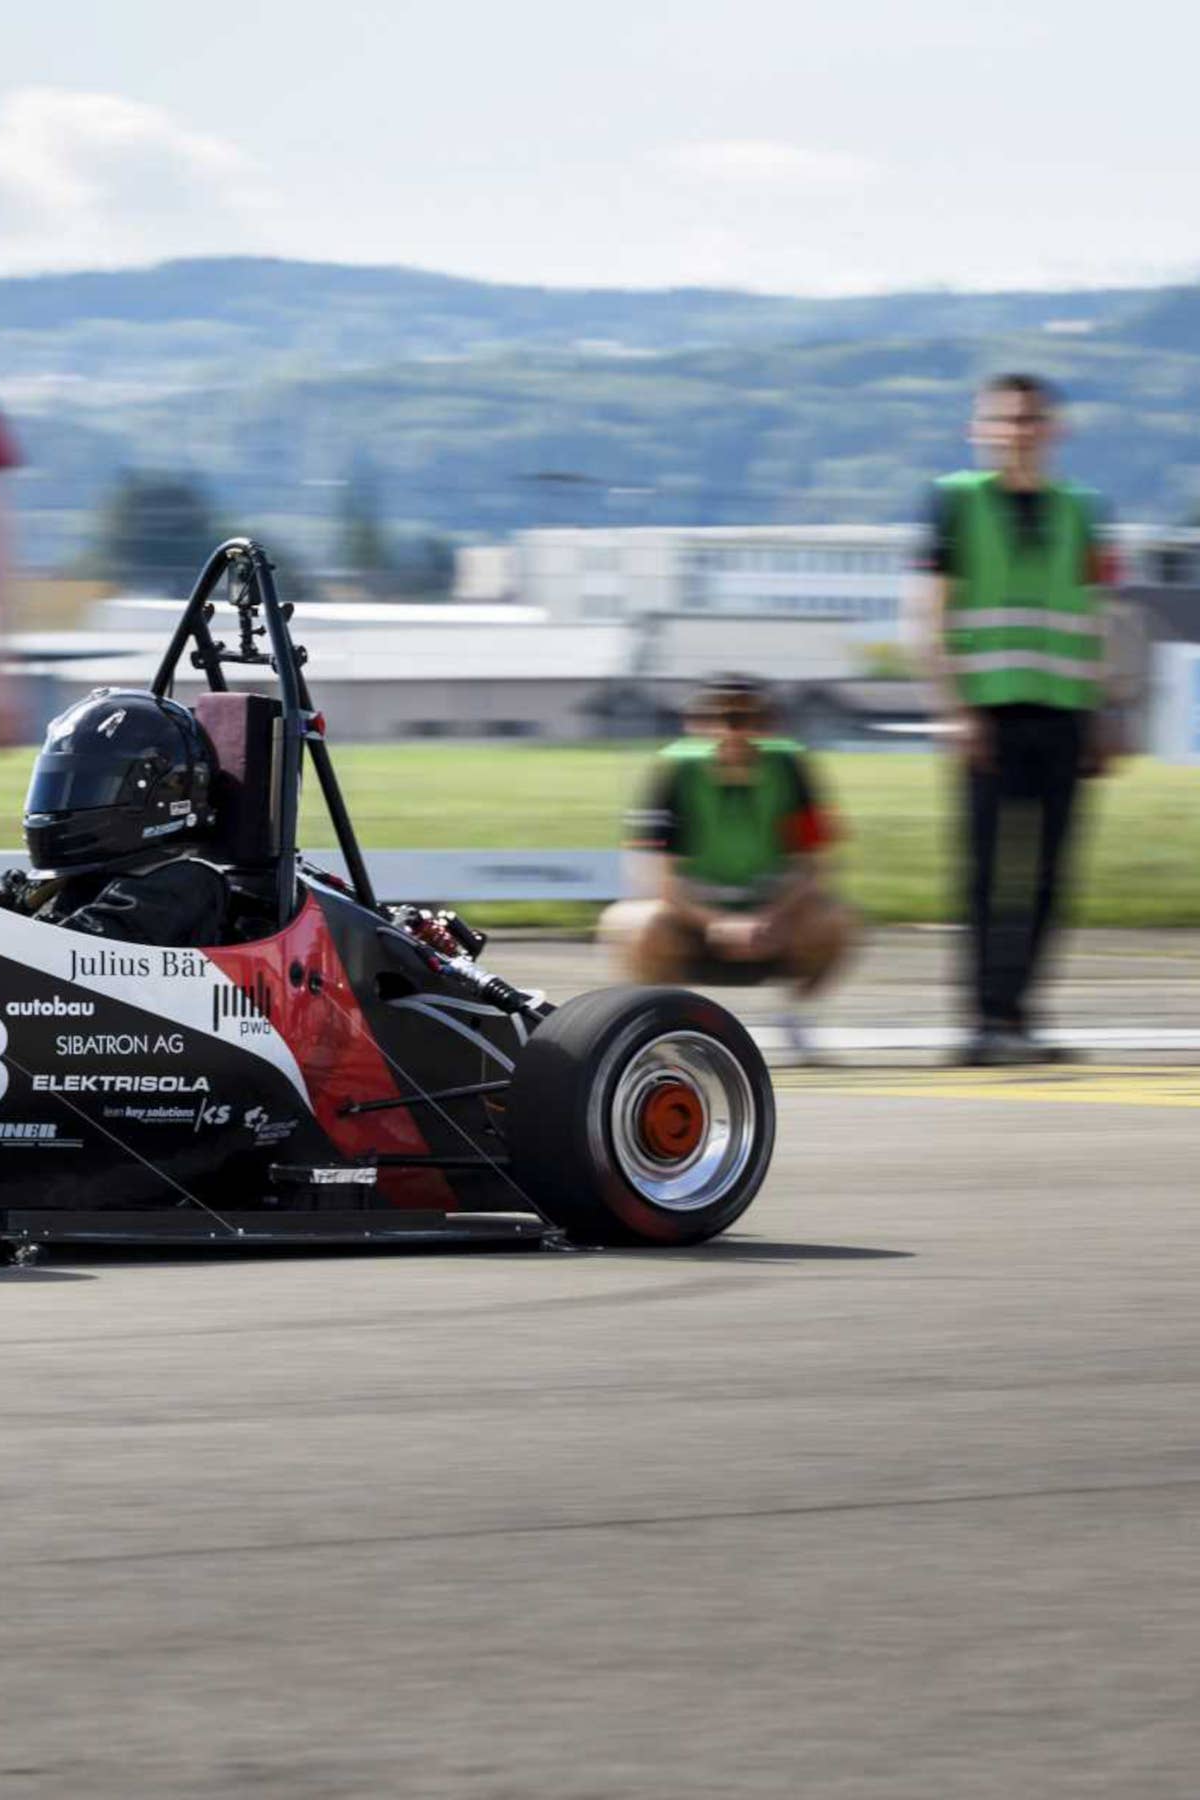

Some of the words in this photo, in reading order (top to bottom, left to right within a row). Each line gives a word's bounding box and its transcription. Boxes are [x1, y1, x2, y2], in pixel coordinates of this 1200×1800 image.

[69, 950, 150, 981] Julius
[161, 951, 211, 977] Bär
[6, 996, 94, 1016] autobau
[240, 1019, 271, 1036] pwb
[56, 1034, 147, 1055] SIBATRON
[152, 1034, 184, 1054] AG
[32, 1075, 211, 1092] ELEKTRISOLA
[147, 1106, 195, 1118] solutions
